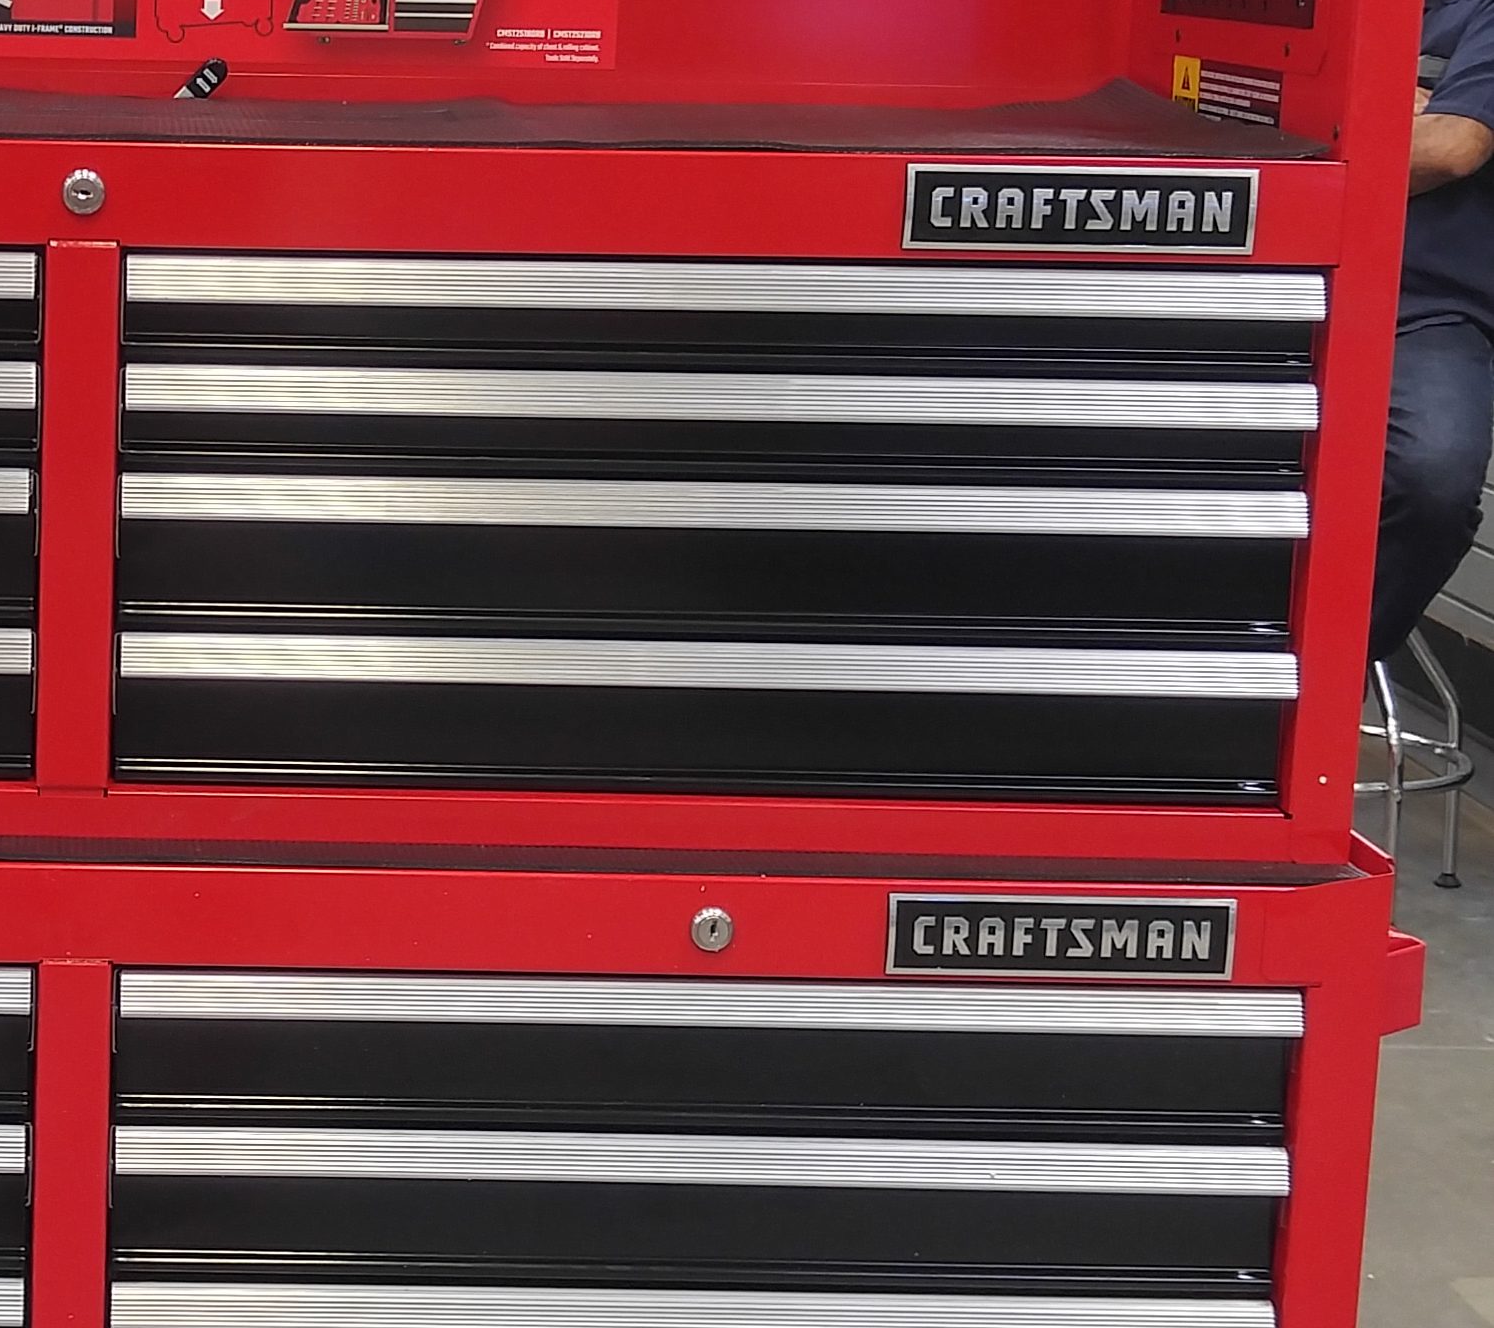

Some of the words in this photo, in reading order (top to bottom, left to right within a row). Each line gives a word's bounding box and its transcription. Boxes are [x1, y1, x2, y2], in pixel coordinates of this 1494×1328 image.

[13, 23, 31, 33] DUTY
[64, 25, 113, 34] CONSTRUCTION
[930, 187, 1234, 232] CRAFTSMAN
[913, 915, 1212, 960] CRAFTSMAN
